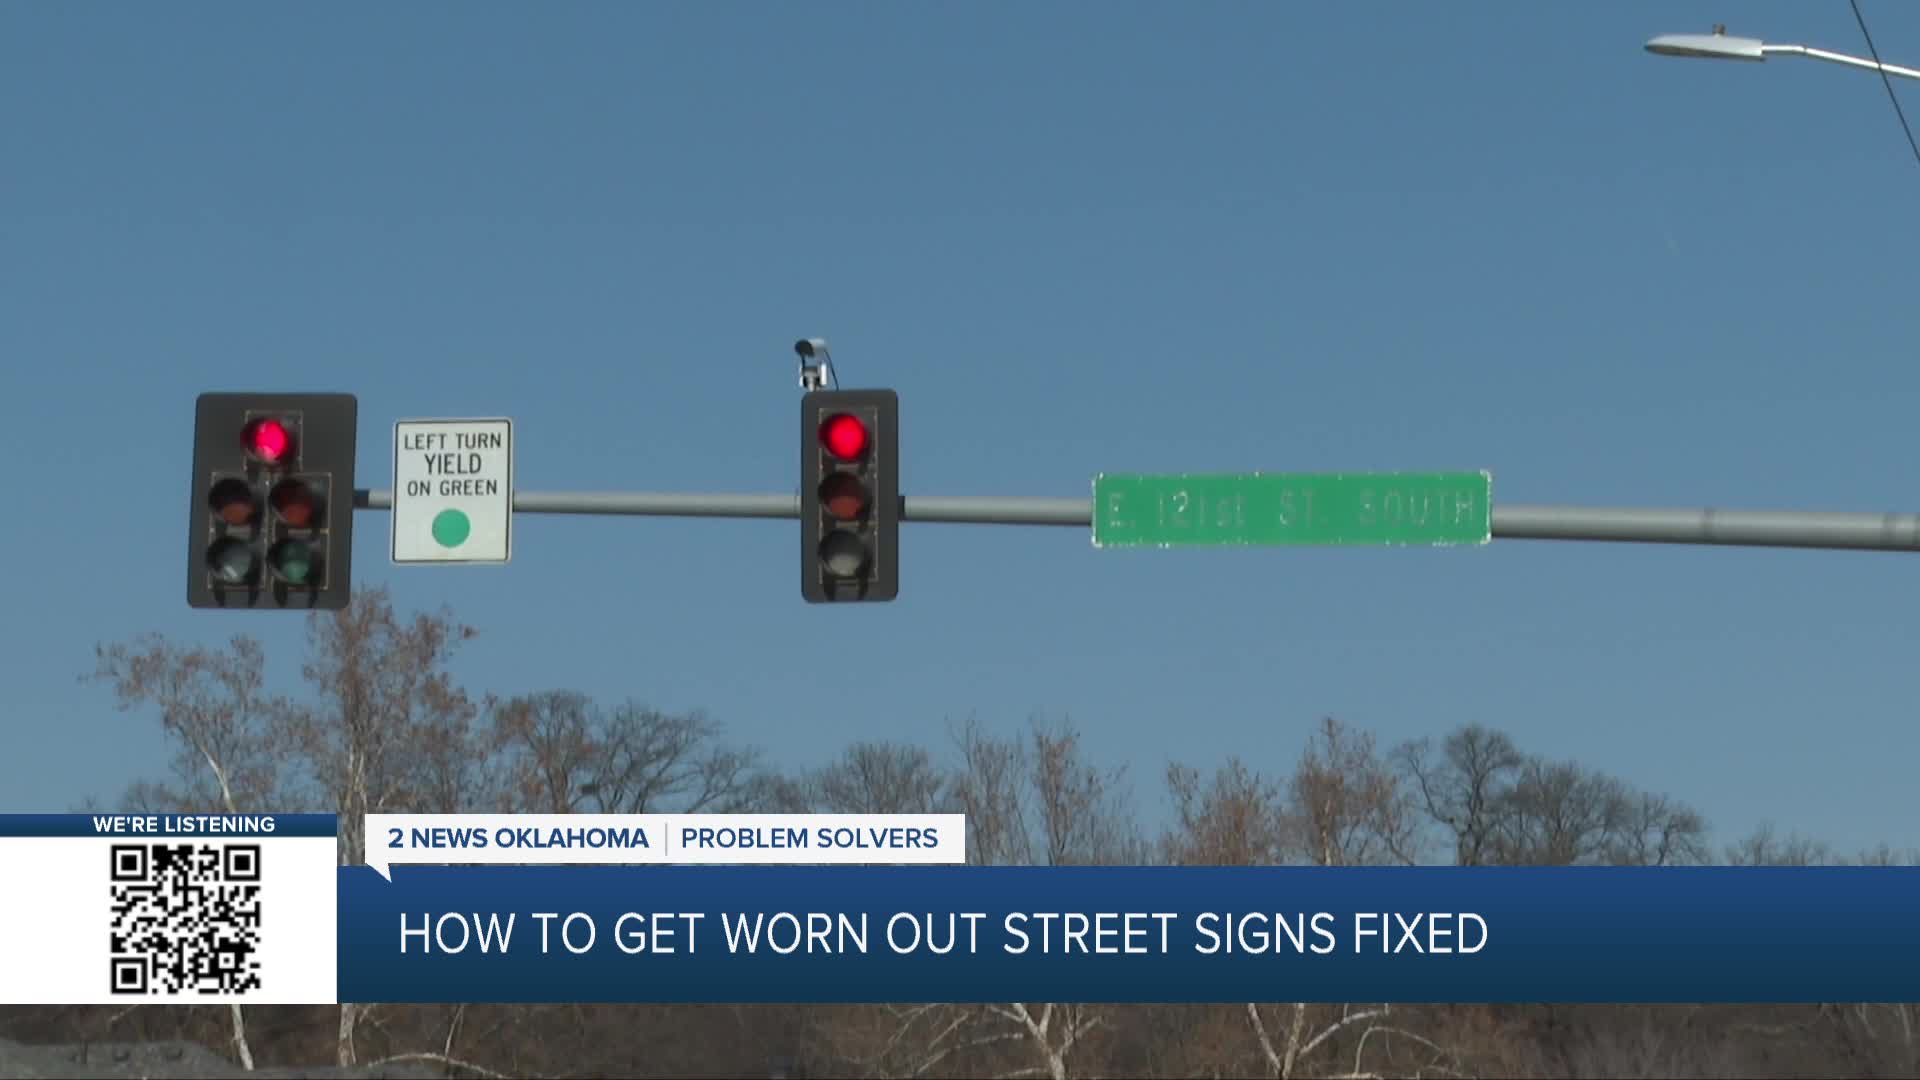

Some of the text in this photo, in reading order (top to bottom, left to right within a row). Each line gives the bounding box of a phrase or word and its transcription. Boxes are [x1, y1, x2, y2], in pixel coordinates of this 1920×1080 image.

[404, 432, 502, 450] LEFT TURN
[424, 453, 482, 475] YIELD
[407, 479, 497, 496] ON GREEN
[1359, 489, 1475, 526] SOUTH
